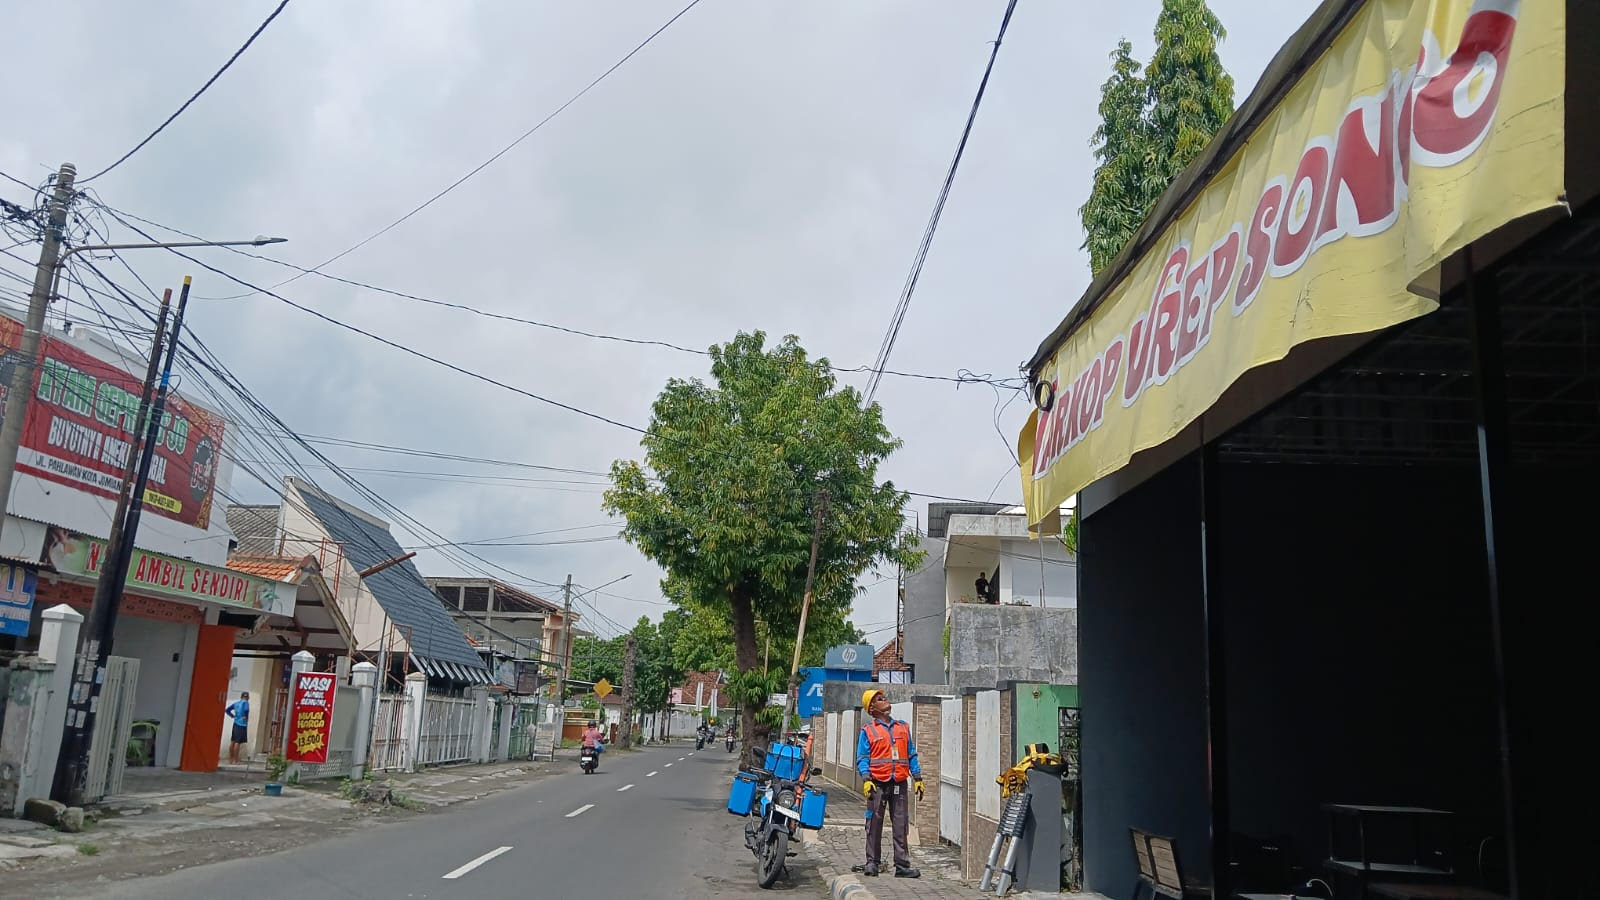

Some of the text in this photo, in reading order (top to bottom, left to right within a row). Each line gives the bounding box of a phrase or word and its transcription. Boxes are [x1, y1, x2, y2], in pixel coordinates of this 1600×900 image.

[1122, 223, 1242, 405] UREP
[1232, 2, 1518, 314] SONO
[37, 356, 97, 418] AYAM
[48, 415, 102, 461] BUYUTNYA
[48, 457, 82, 479] PAHLAWAN
[135, 555, 186, 590] AMBIL
[191, 567, 249, 601] SENDIRI
[299, 676, 332, 691] NASI
[297, 719, 325, 729] HARGA
